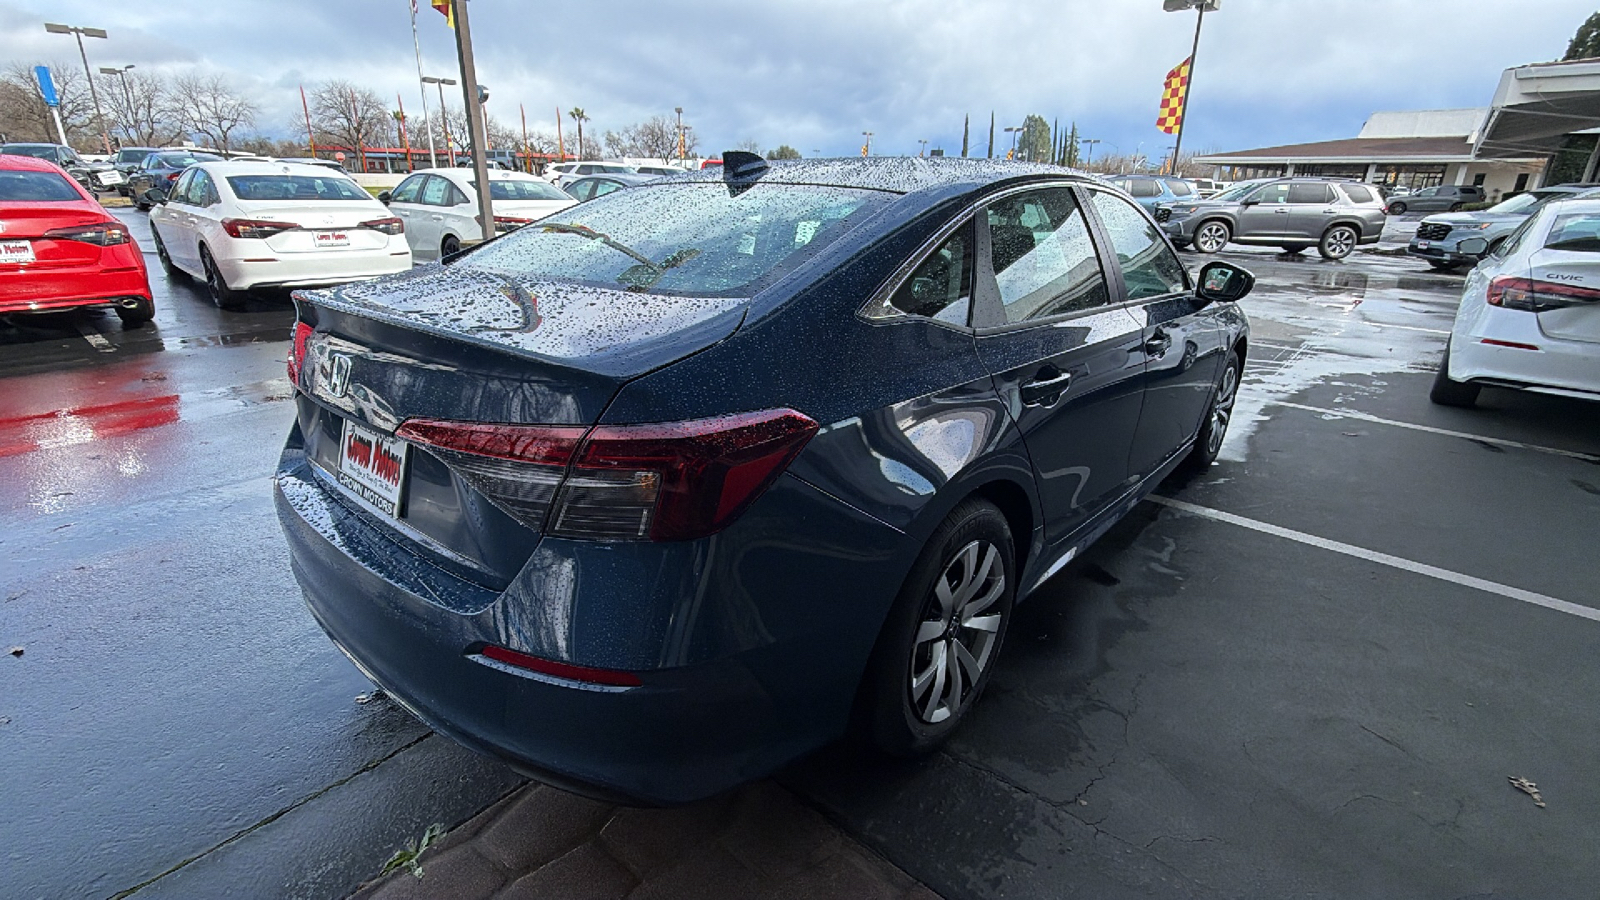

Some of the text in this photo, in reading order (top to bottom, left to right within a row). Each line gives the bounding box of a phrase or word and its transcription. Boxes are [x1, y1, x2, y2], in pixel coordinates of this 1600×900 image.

[1546, 273, 1584, 281] CIVIC
[339, 472, 363, 497] CROWN
[363, 487, 393, 514] MOTORS
